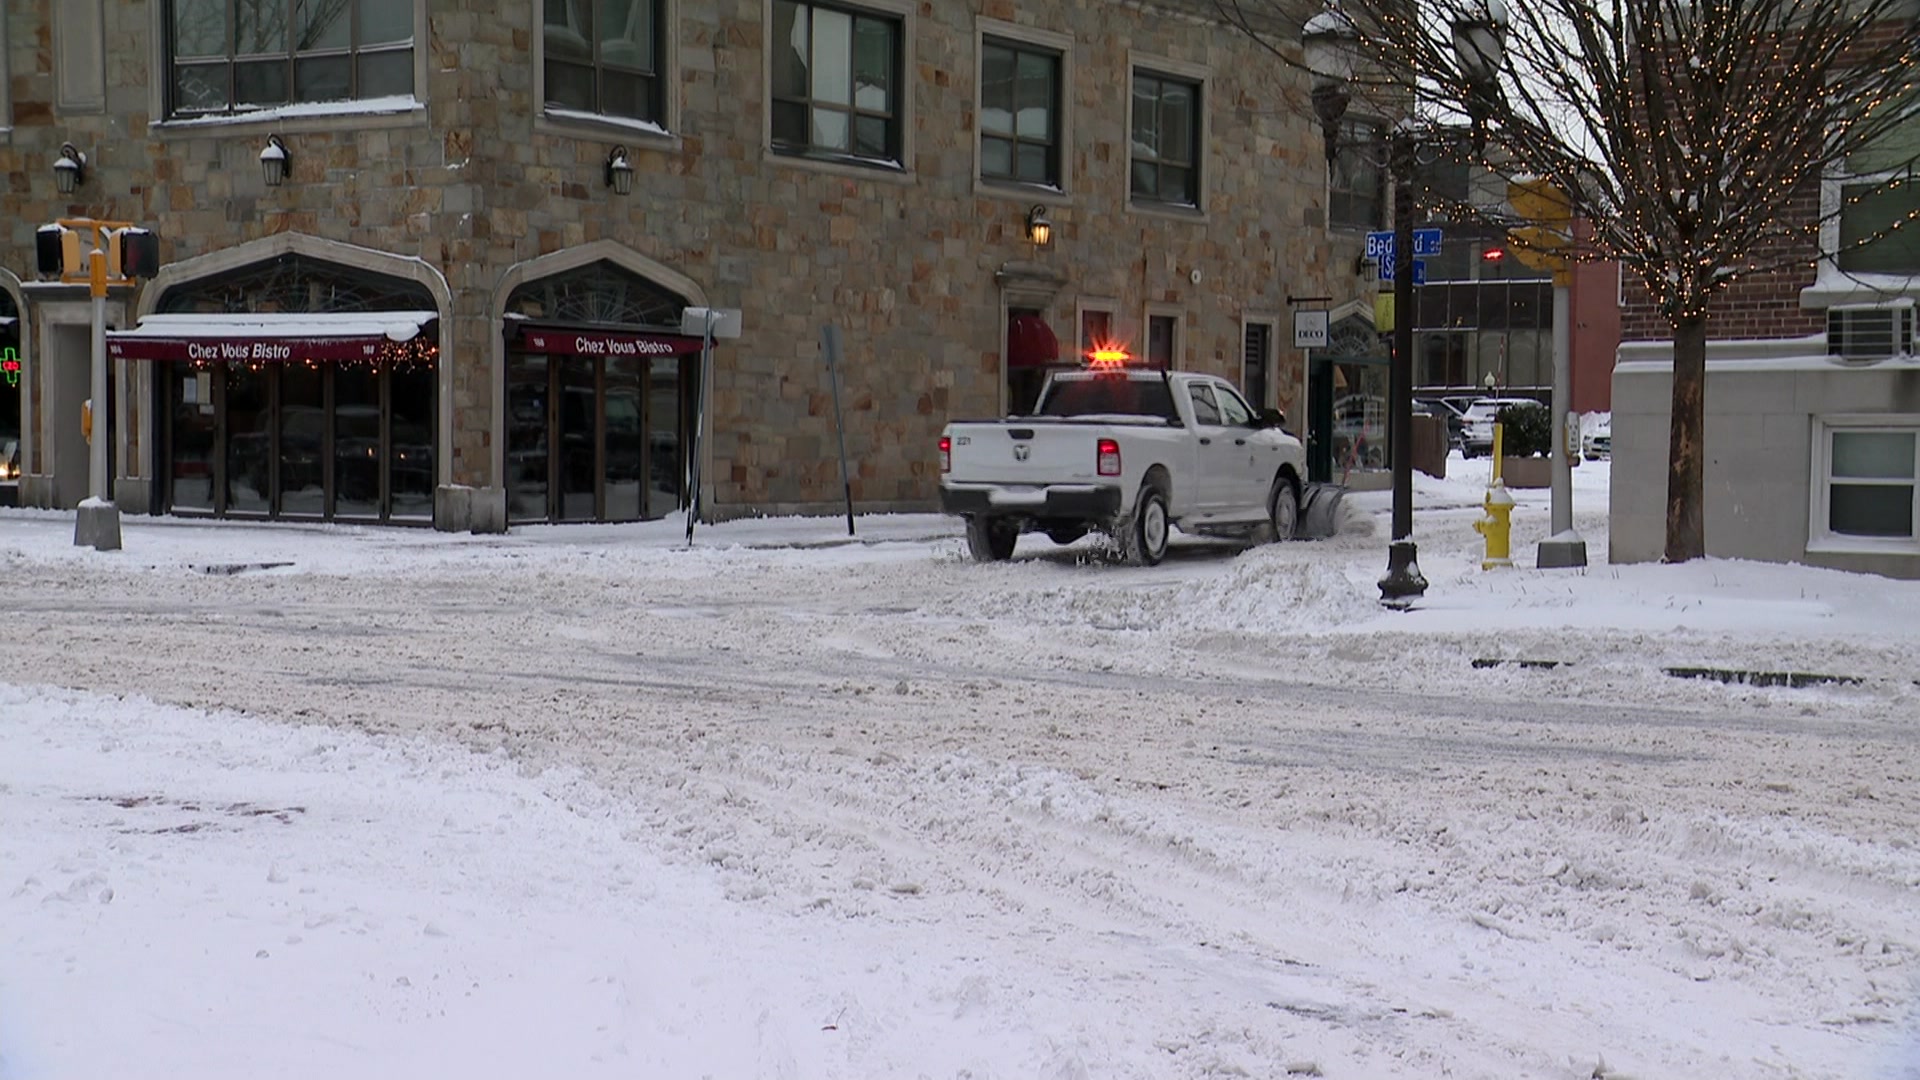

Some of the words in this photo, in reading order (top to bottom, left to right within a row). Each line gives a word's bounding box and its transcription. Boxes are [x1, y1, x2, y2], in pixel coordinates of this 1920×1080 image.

[1367, 234, 1424, 255] Bedd
[1298, 330, 1324, 339] DECO
[188, 343, 218, 358] Chez
[221, 343, 249, 358] Vous
[252, 343, 290, 358] Bistro
[575, 336, 605, 353] Chez
[605, 338, 636, 354] Vous
[635, 340, 673, 353] Bistro
[957, 437, 971, 445] 221
